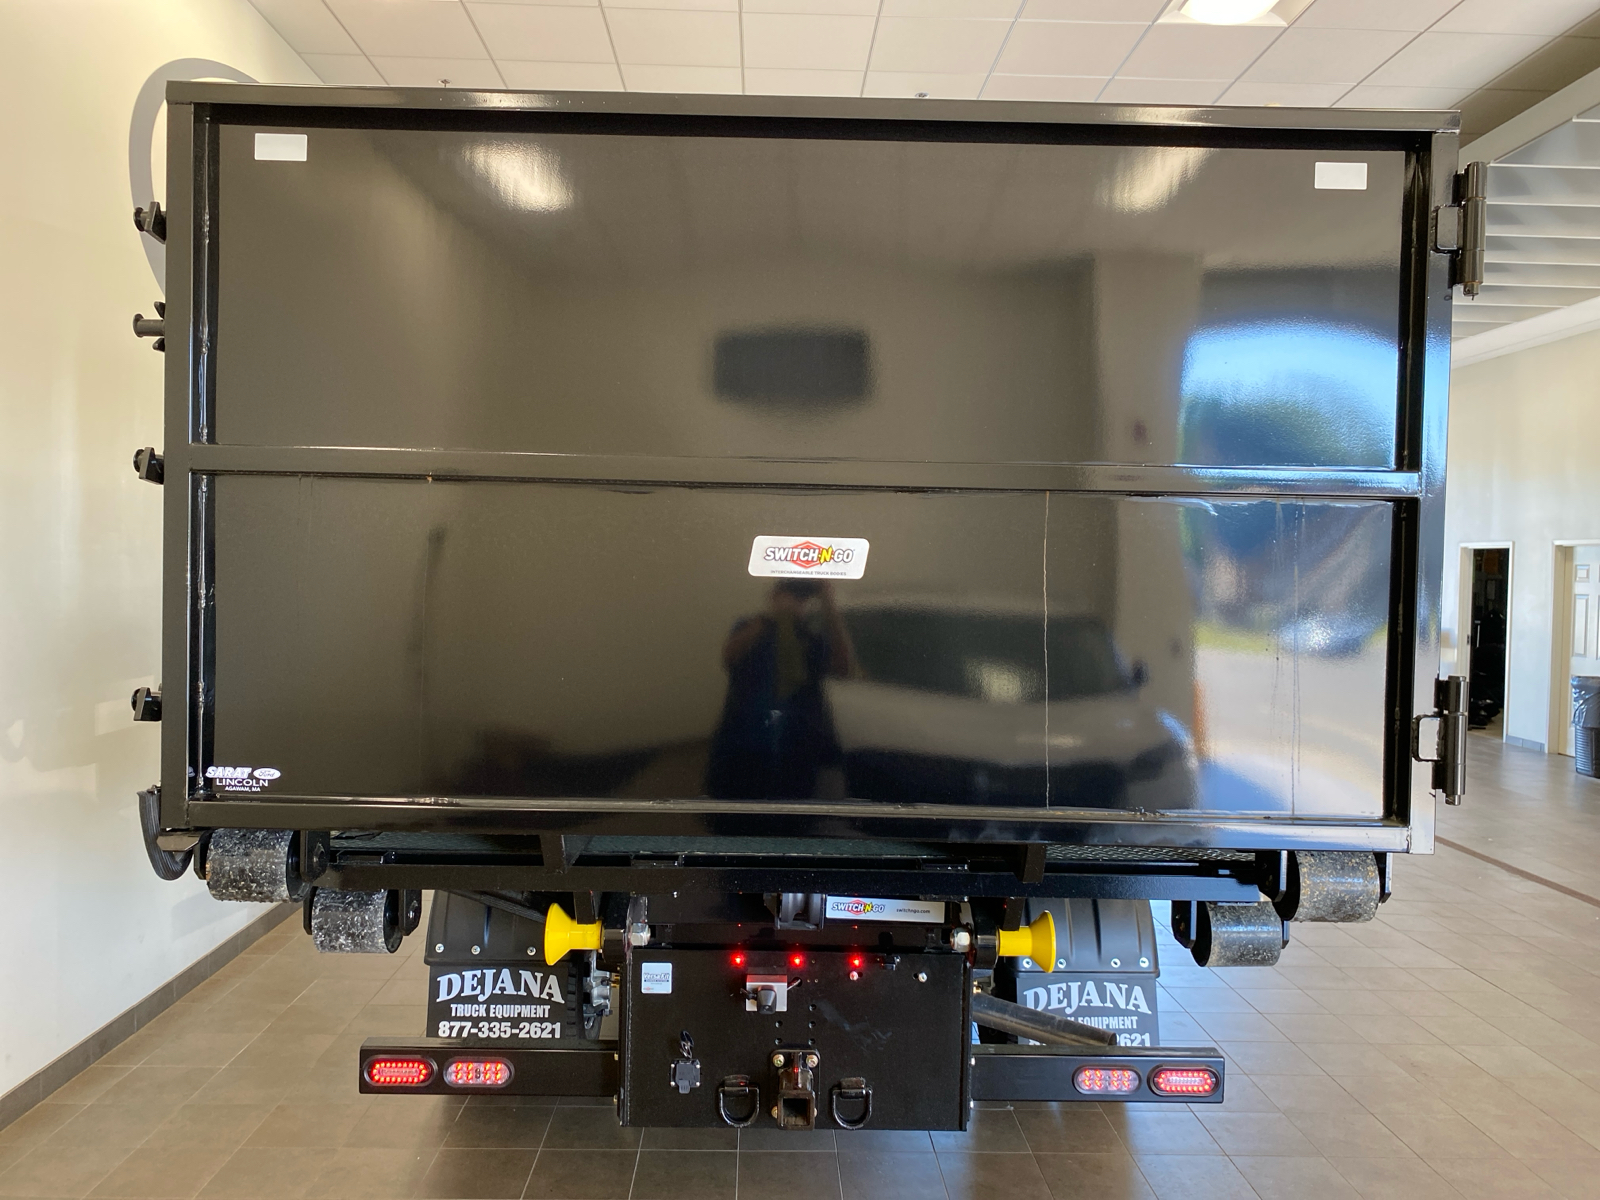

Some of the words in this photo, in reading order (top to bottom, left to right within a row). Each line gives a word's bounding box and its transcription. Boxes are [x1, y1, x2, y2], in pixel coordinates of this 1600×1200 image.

[205, 766, 252, 779] SARAT
[216, 778, 269, 787] LINCOLN
[436, 968, 565, 1004] DEJANA
[1023, 980, 1152, 1015] DEJANA
[450, 1004, 487, 1017] TRUCK
[489, 1004, 551, 1018] EQUIPMENT
[438, 1021, 561, 1039] 877-335-2621
